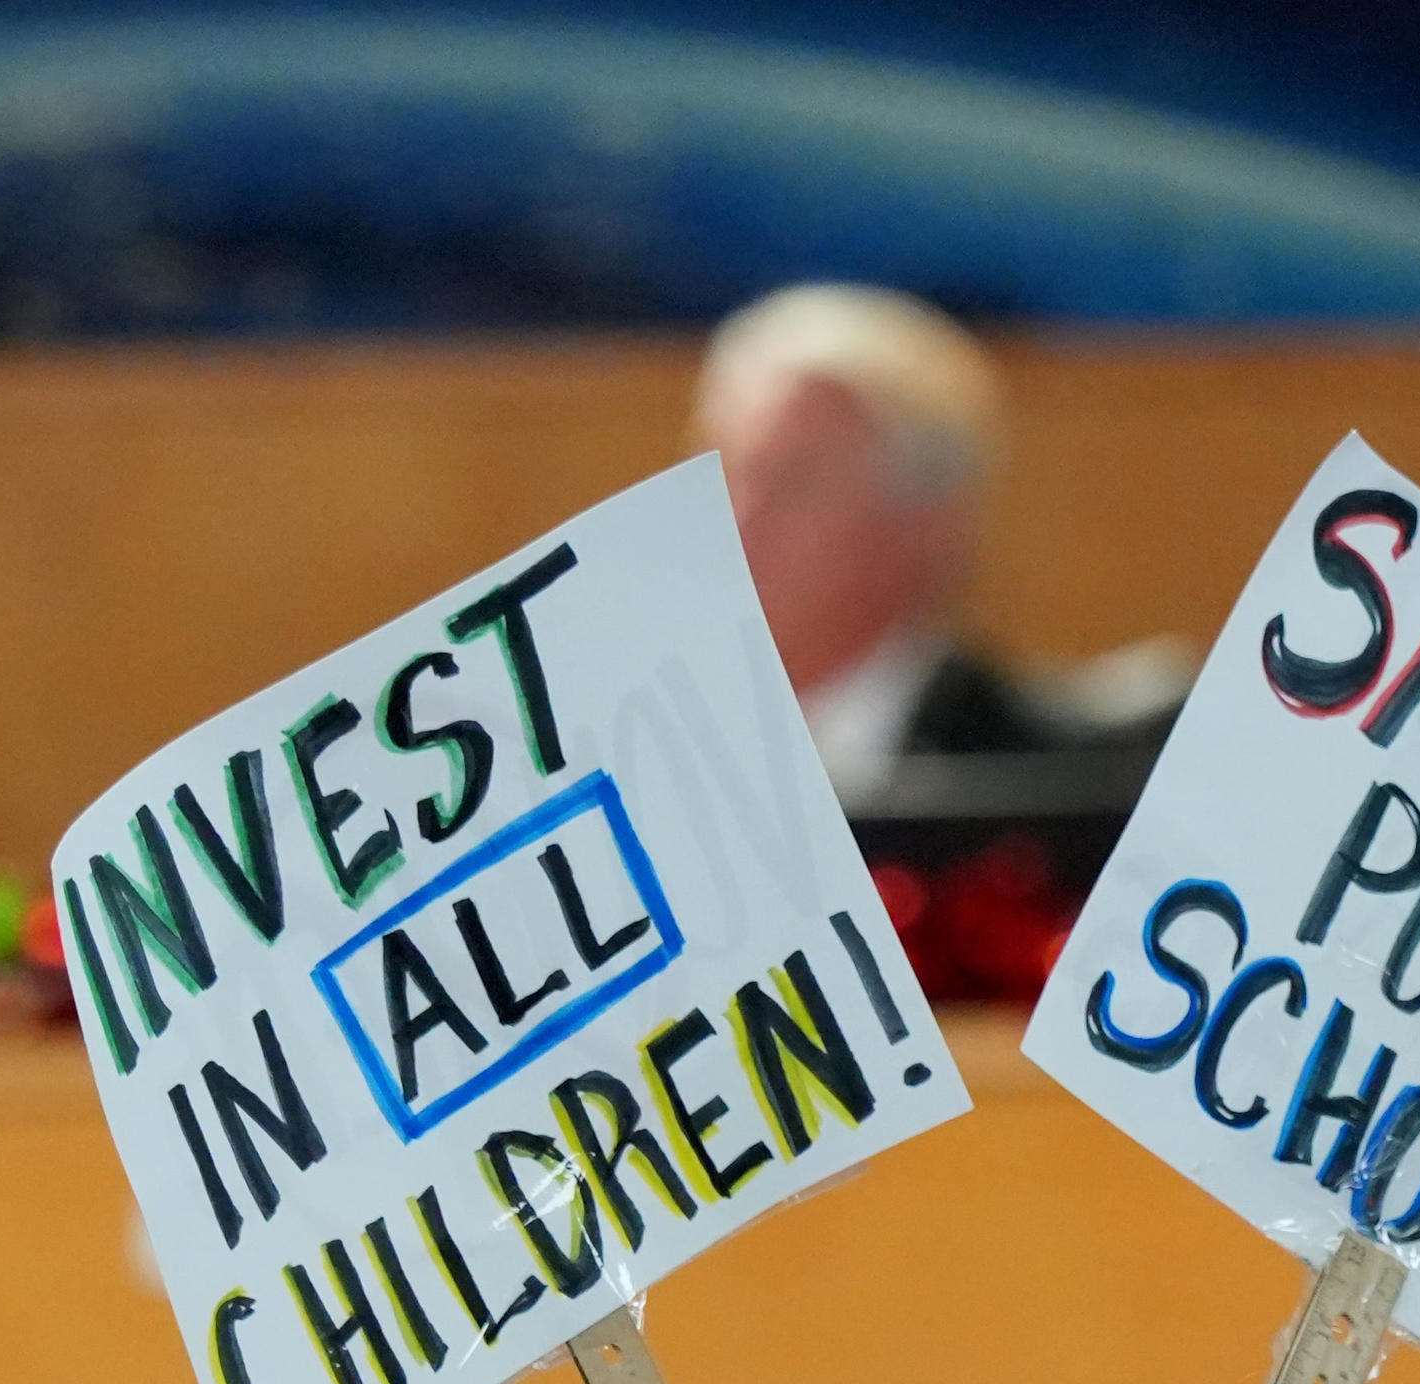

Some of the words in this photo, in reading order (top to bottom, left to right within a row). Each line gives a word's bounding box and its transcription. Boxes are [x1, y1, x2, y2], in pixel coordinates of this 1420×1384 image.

[64, 542, 578, 1075] INVEST
[168, 1010, 327, 1249] IN
[382, 843, 651, 1103] ALL
